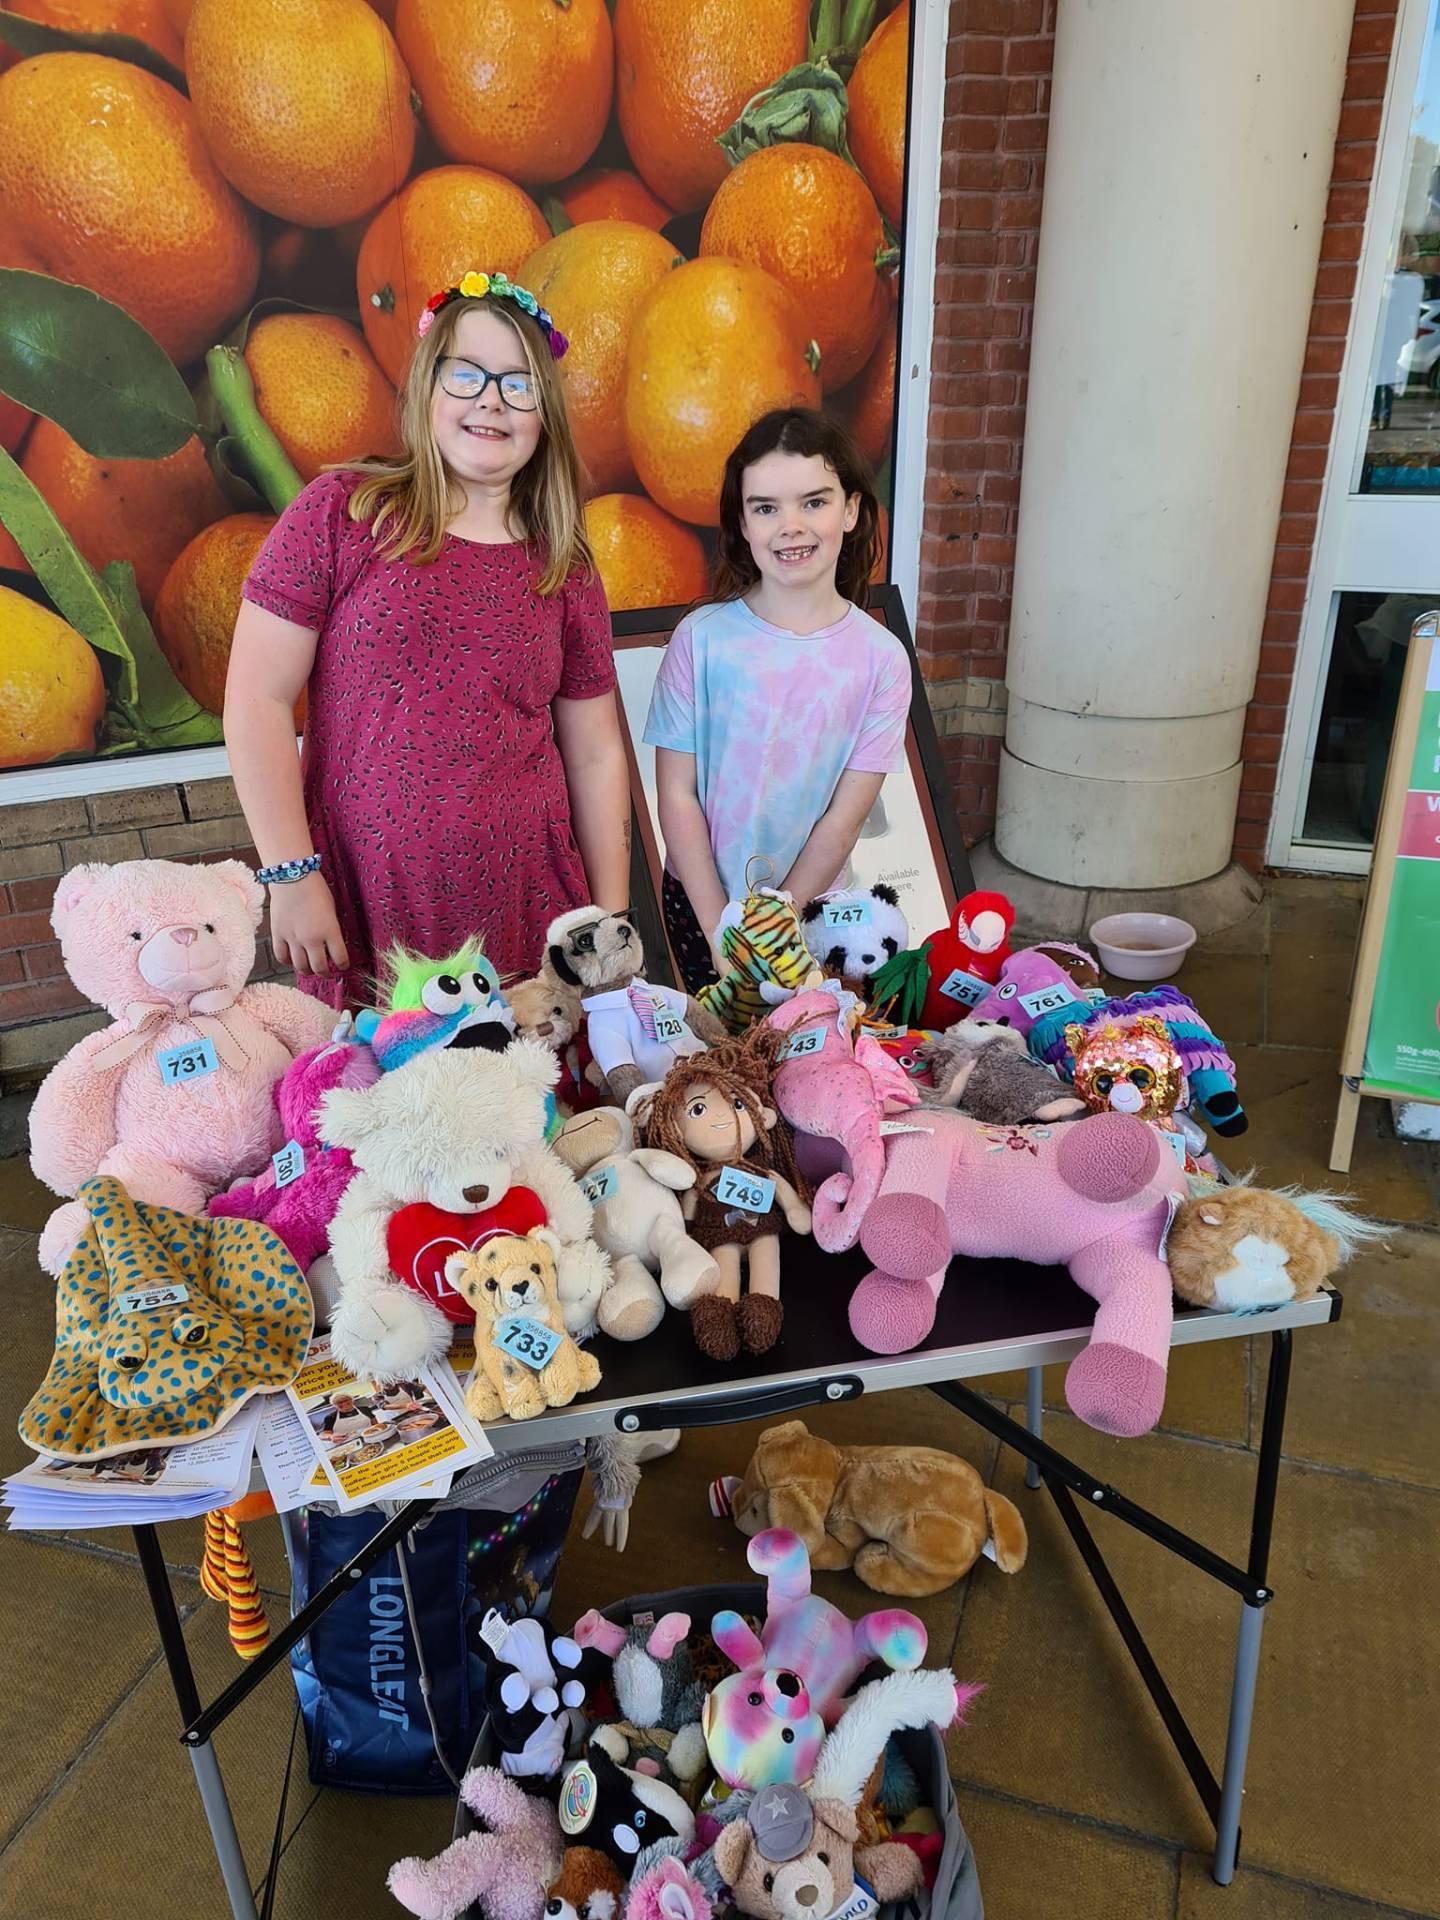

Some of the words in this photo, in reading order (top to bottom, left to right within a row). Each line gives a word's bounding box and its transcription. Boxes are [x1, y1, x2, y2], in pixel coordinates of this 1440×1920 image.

[877, 868, 920, 881] Available
[829, 909, 863, 924] 747
[948, 981, 981, 1003] 751
[1030, 994, 1066, 1012] 761
[657, 1020, 682, 1037] 728
[168, 1053, 208, 1078] 731
[277, 1152, 293, 1181] 730
[583, 1178, 608, 1201] 27
[724, 1181, 764, 1207] 749
[127, 1292, 178, 1309] 754
[504, 1325, 549, 1361] 733
[295, 1376, 326, 1389] price
[328, 1369, 338, 1379] of
[317, 1362, 338, 1375] you
[299, 1384, 326, 1397] feed
[328, 1380, 336, 1388] 5
[341, 1473, 353, 1481] For
[358, 1466, 370, 1475] the
[374, 1457, 392, 1469] price
[417, 1440, 432, 1451] high
[436, 1430, 456, 1441] street
[370, 1470, 382, 1478] we
[383, 1463, 398, 1475] give
[407, 1450, 431, 1465] people
[432, 1443, 444, 1451] the
[347, 1485, 361, 1494] hot
[361, 1478, 377, 1488] meal
[377, 1471, 396, 1483] they
[397, 1464, 410, 1475] will
[410, 1459, 428, 1468] have
[428, 1451, 442, 1461] that
[442, 1446, 456, 1456] day
[369, 1577, 409, 1732] LONGLEAT
